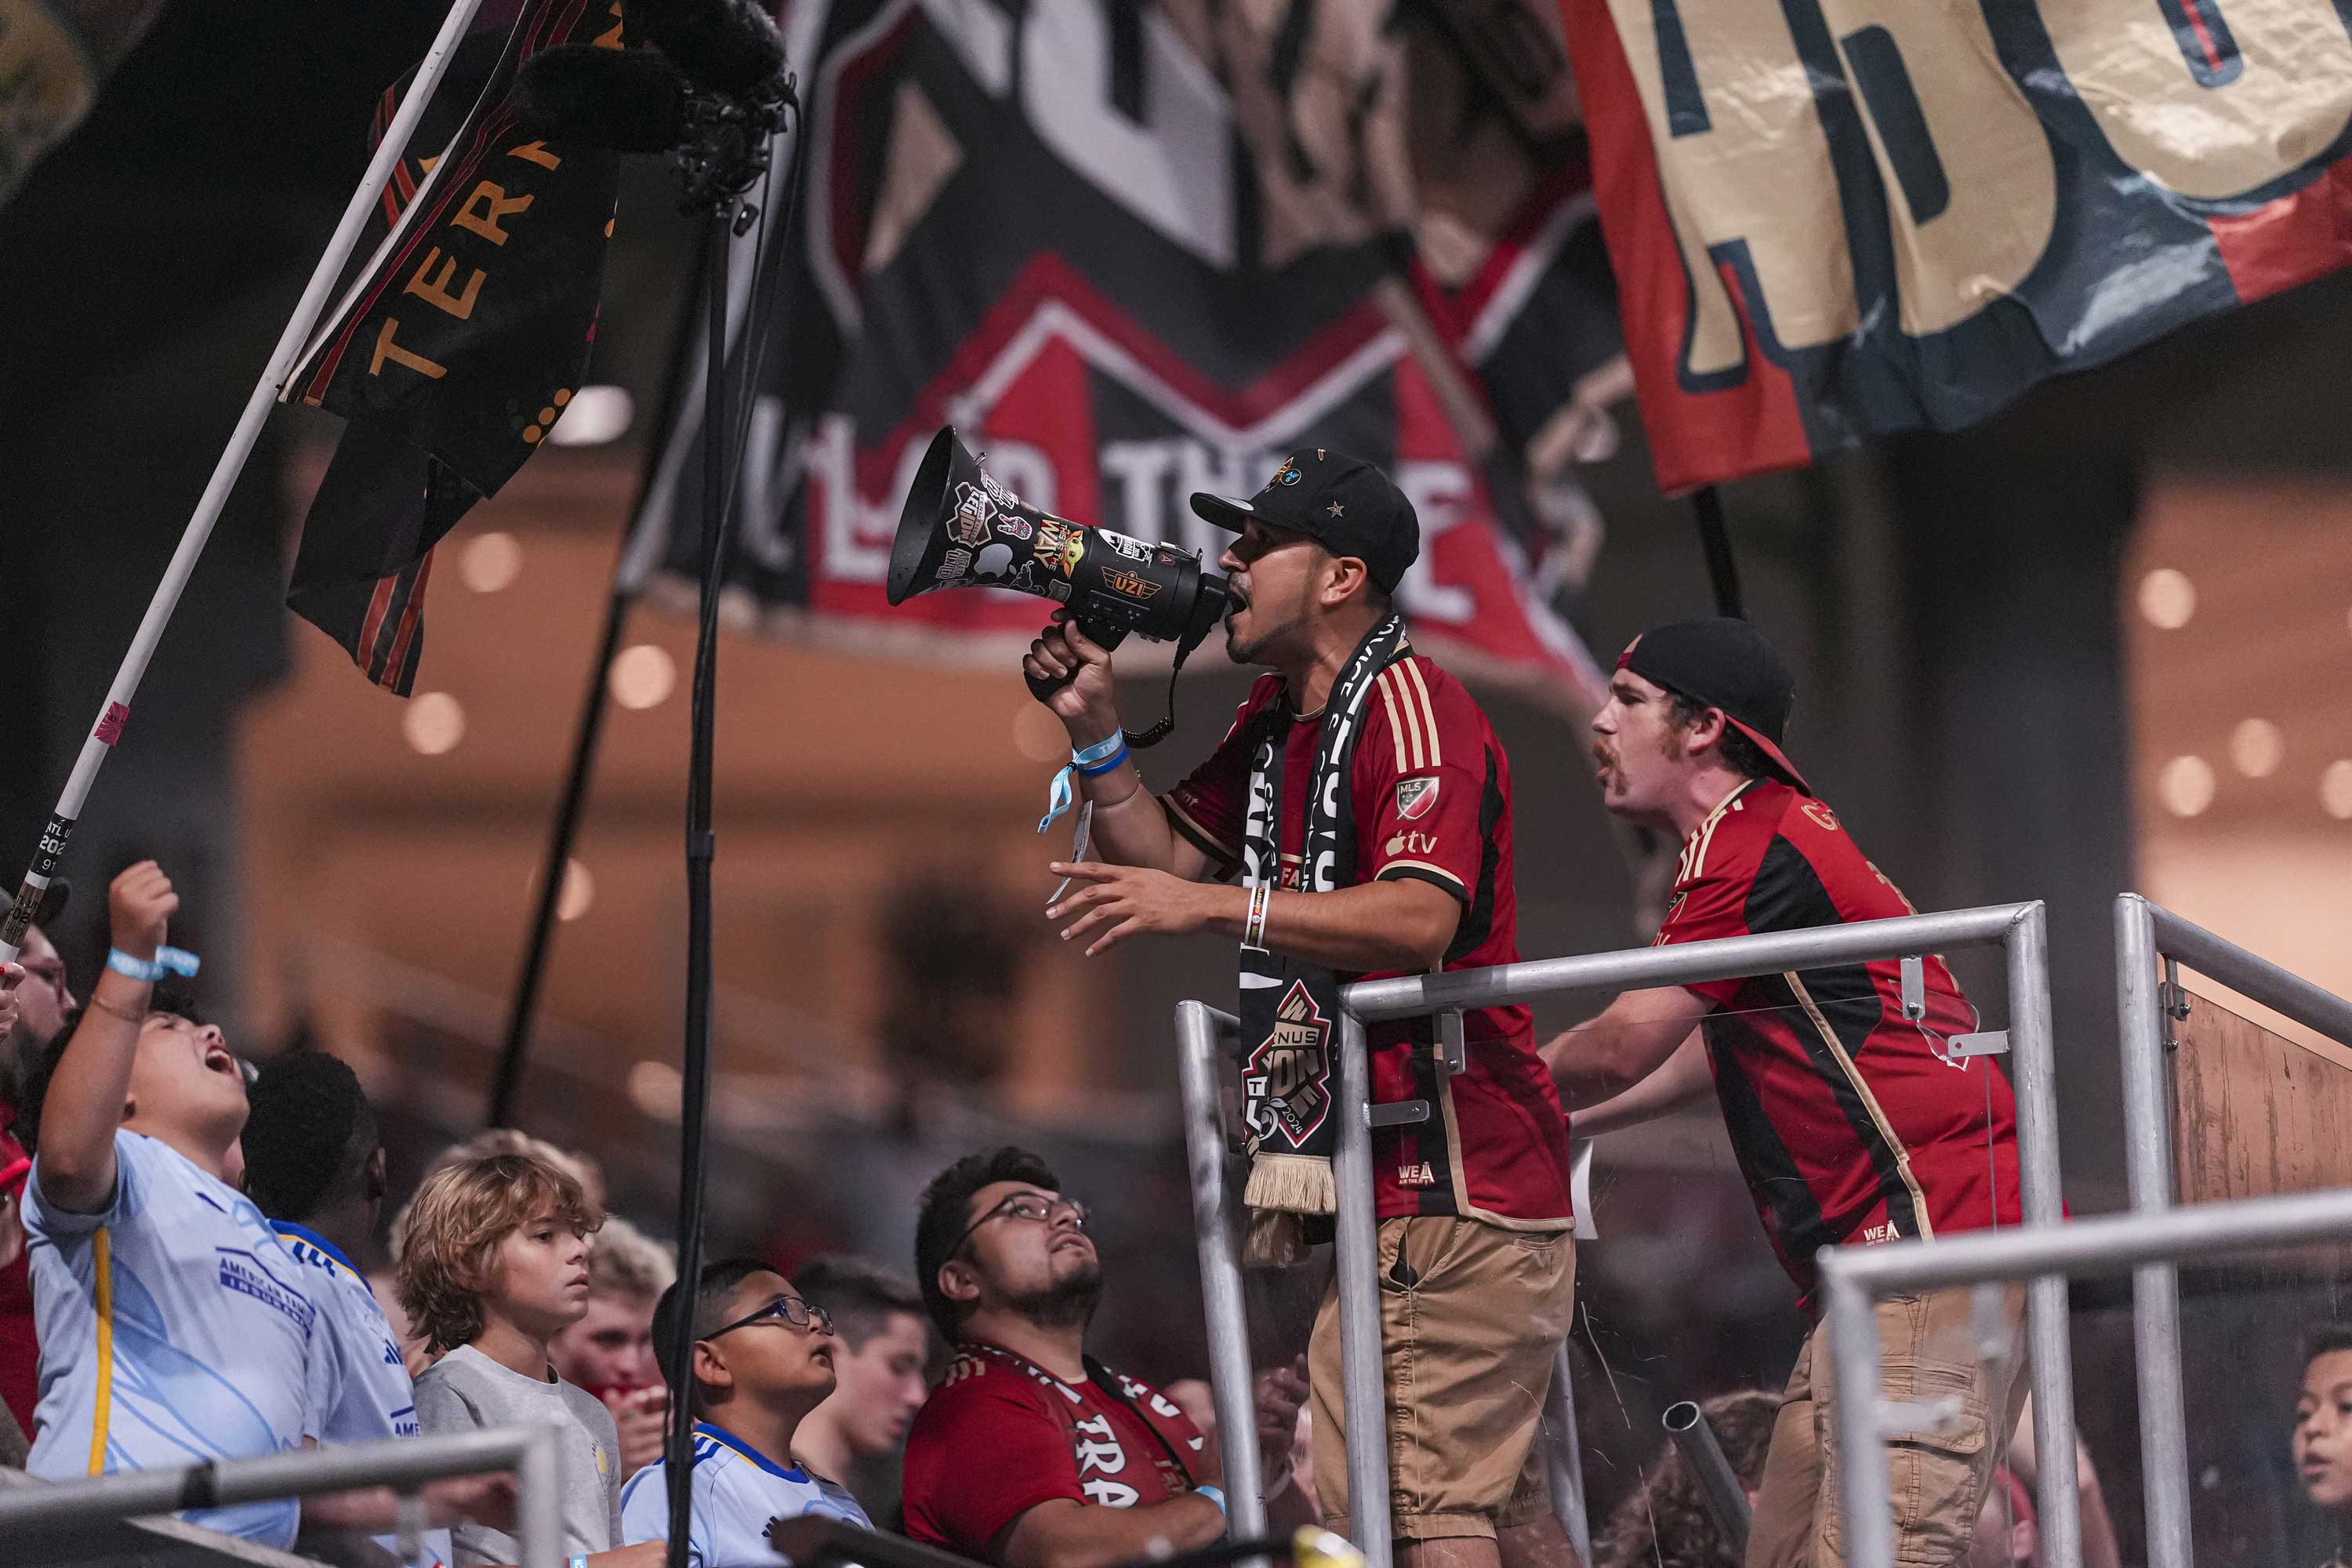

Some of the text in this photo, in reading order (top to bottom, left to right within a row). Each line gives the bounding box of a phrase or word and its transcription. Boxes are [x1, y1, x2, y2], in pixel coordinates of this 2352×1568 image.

[960, 491, 980, 540] LEGION
[1033, 519, 1060, 569] WAY
[1048, 524, 1069, 571] THIS IS THE
[1115, 576, 1144, 596] UZI
[1400, 782, 1421, 793] MLS
[45, 822, 61, 837] ATL
[1408, 831, 1437, 854] tv
[1281, 1106, 1304, 1134] 2024
[1398, 1165, 1419, 1178] WE
[1863, 1225, 1886, 1241] WE
